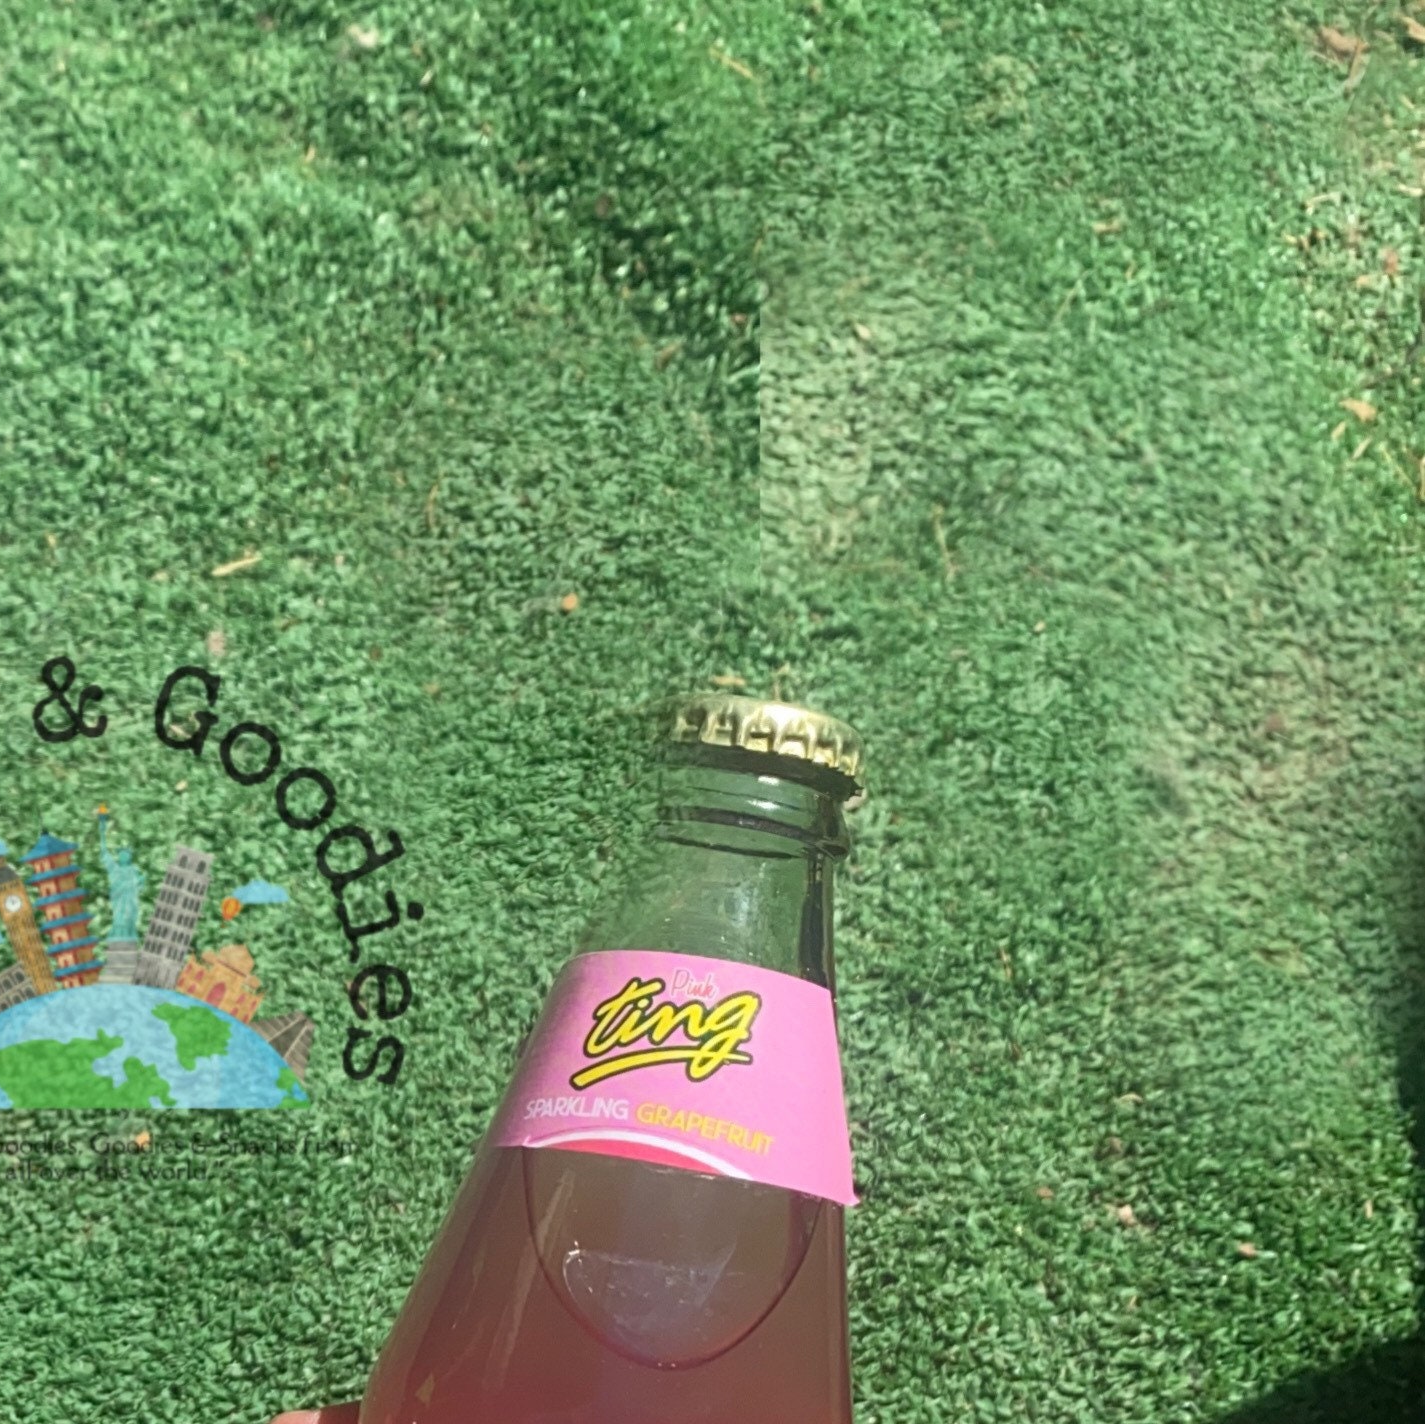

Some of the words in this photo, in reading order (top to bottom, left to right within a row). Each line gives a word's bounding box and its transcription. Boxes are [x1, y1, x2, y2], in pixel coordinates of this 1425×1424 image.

[583, 977, 762, 1083] ting
[523, 1096, 629, 1121] SPARKLING
[636, 1103, 773, 1154] GRAPEFRUIT
